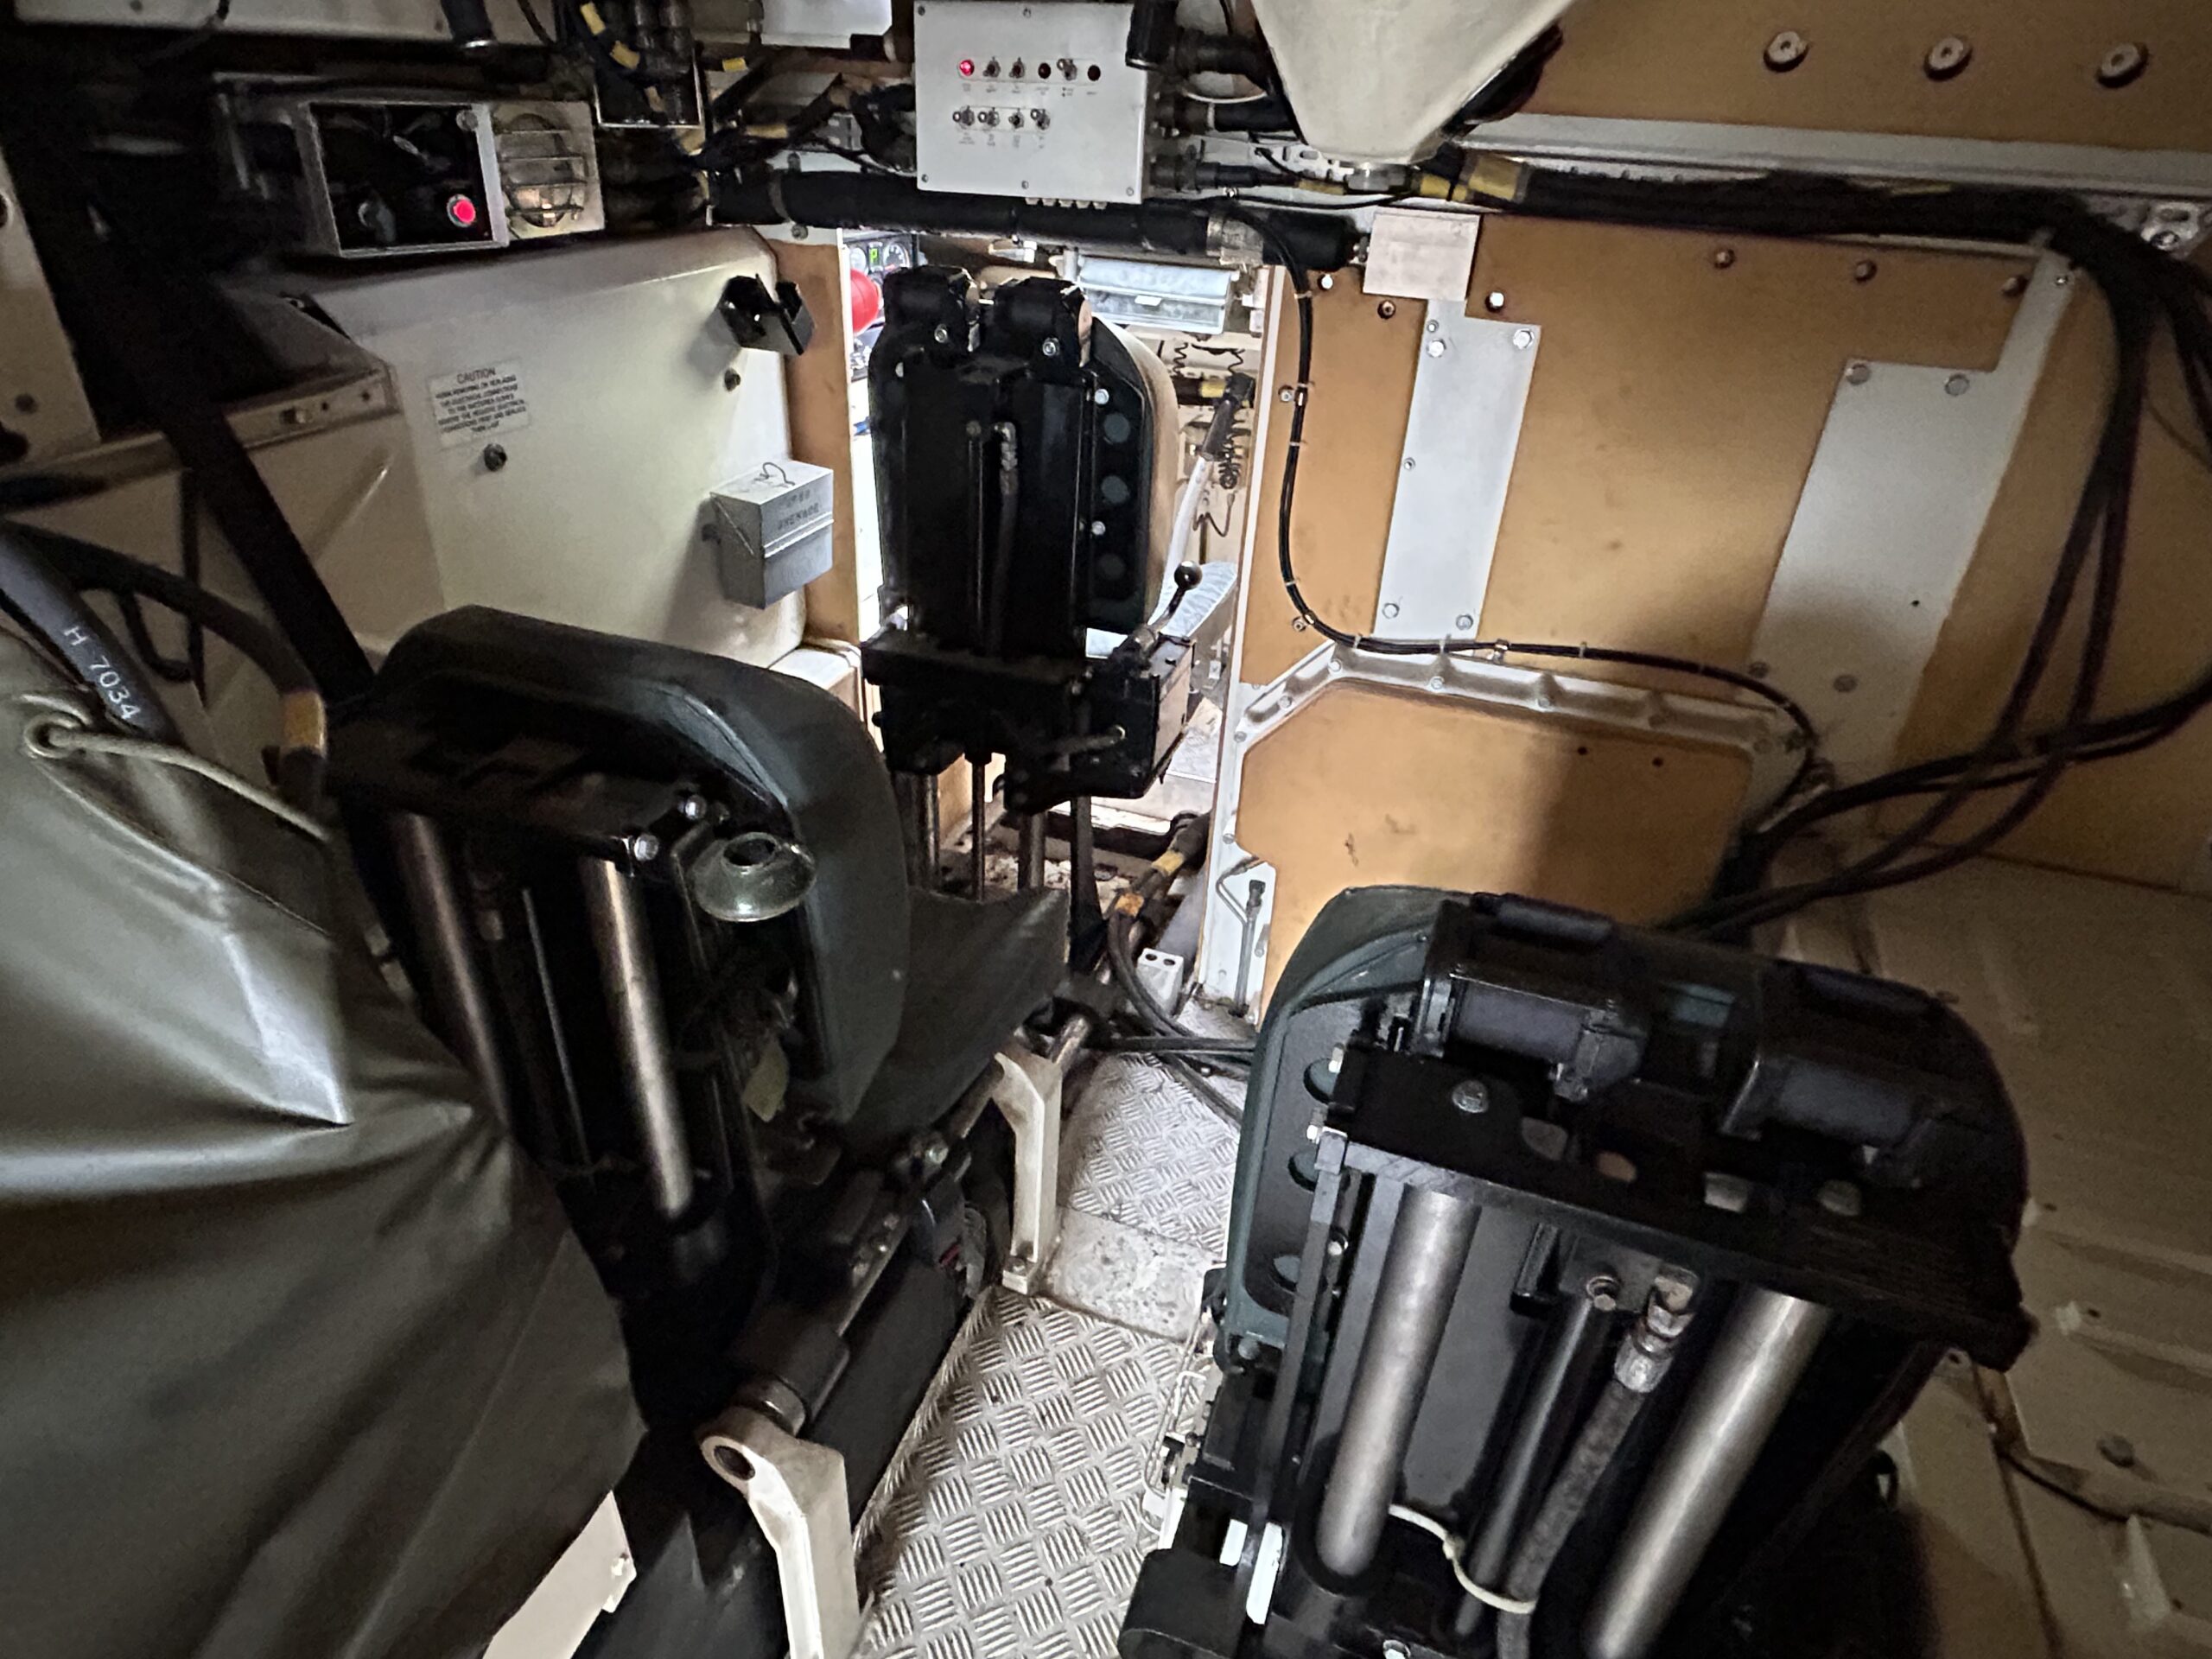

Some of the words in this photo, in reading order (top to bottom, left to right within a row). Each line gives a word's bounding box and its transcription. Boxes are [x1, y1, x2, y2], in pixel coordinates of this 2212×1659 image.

[456, 367, 496, 384] CAUTION
[64, 626, 89, 645] H
[90, 655, 141, 719] 7034
